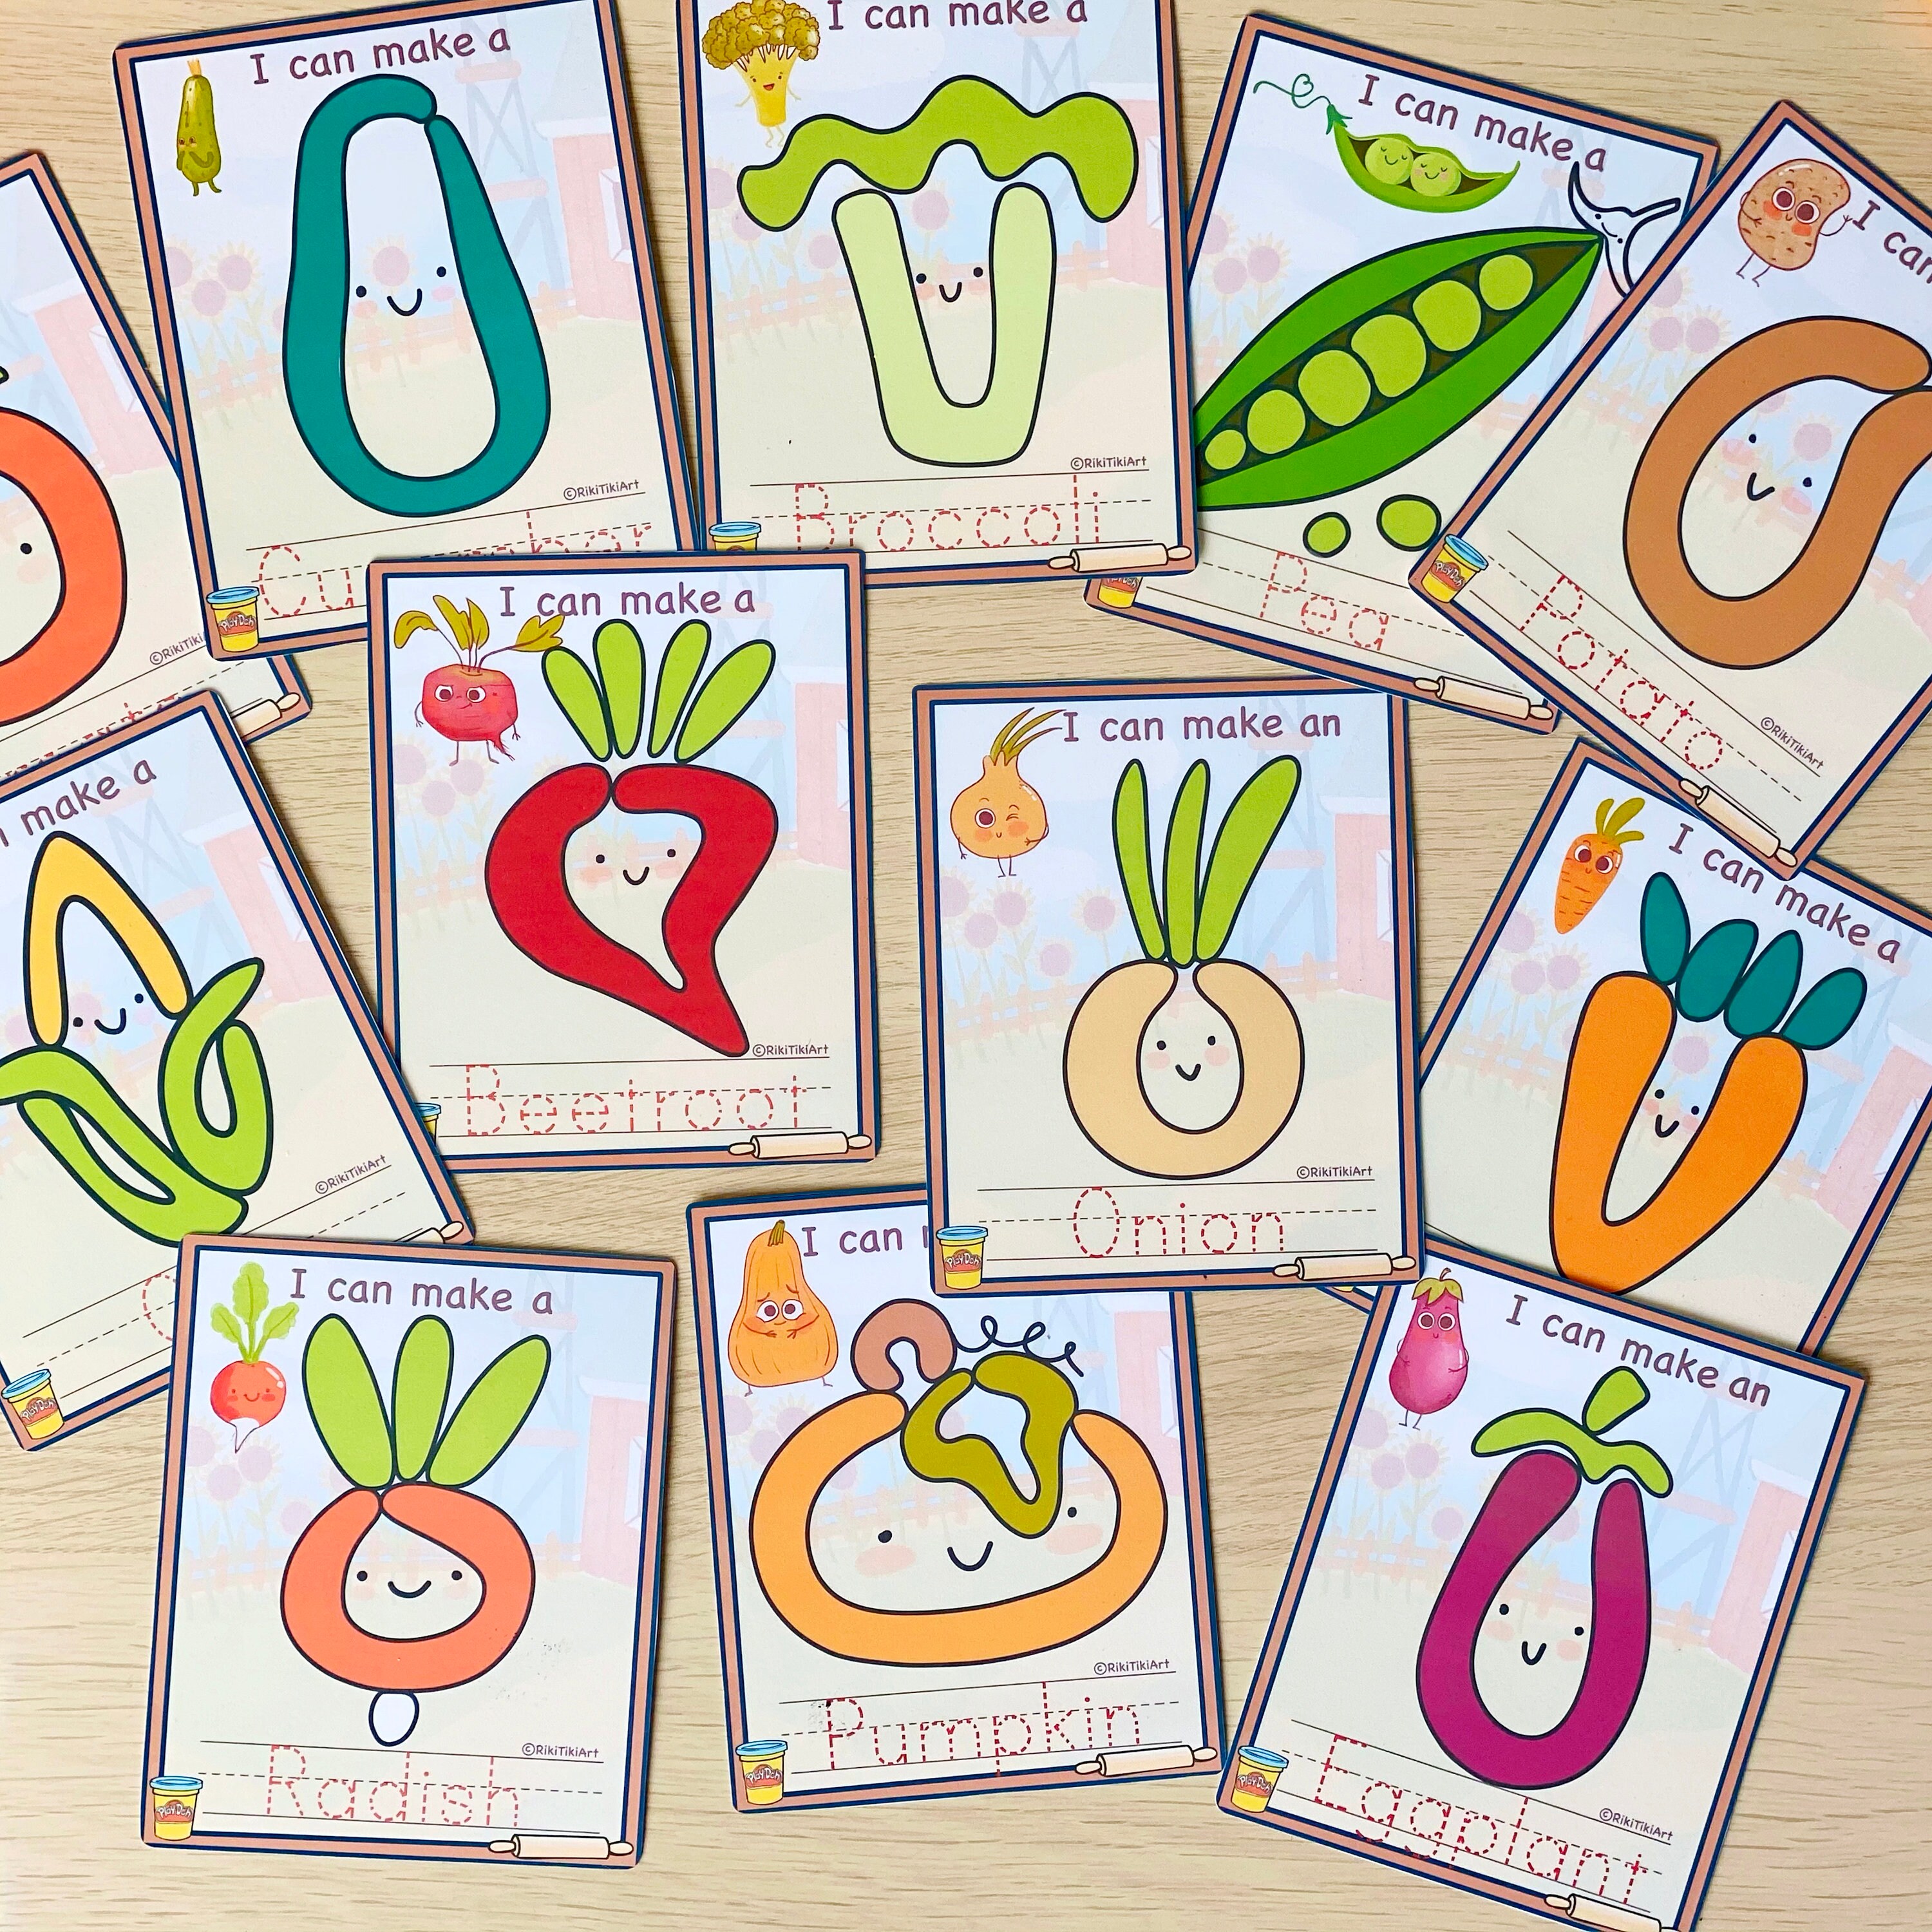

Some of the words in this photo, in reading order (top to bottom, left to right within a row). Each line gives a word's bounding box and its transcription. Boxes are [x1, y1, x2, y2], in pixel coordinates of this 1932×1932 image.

[828, 0, 844, 30] I
[866, 5, 929, 29] can
[949, 0, 1049, 26] make
[1066, 0, 1088, 23] a
[250, 53, 269, 84] I
[290, 50, 355, 80] can
[372, 28, 475, 68] make
[489, 28, 510, 52] a
[1358, 74, 1379, 106] I
[1396, 92, 1459, 130] can
[1475, 113, 1573, 161] make
[1585, 148, 1606, 172] a
[1852, 200, 1880, 231] I
[793, 474, 1099, 552] Broccoli
[500, 587, 515, 616] I
[537, 593, 600, 617] can
[621, 582, 721, 615] make
[735, 590, 755, 612] a
[1259, 551, 1390, 651] Pea
[1520, 574, 1723, 771] Potato
[1063, 711, 1079, 742] I
[1101, 718, 1163, 741] can
[1184, 706, 1283, 739] make
[1300, 715, 1340, 737] an
[20, 775, 120, 836] make
[134, 760, 156, 784] a
[1669, 823, 1694, 854] I
[1703, 849, 1764, 894] can
[1775, 884, 1871, 947] make
[1878, 940, 1900, 963] a
[465, 1064, 808, 1137] Beetroot
[801, 1227, 818, 1257] I
[840, 1228, 902, 1254] can
[1072, 1186, 1283, 1258] Onion
[290, 1269, 307, 1298] I
[328, 1278, 392, 1304] can
[412, 1278, 512, 1311] make
[533, 1292, 552, 1314] a
[1506, 1294, 1528, 1325] I
[1543, 1315, 1605, 1352] can
[1620, 1338, 1719, 1389] make
[1729, 1378, 1770, 1406] an
[826, 1681, 1140, 1776] Pumpkin
[267, 1744, 519, 1826] Radish
[1314, 1734, 1647, 1906] Eggplant
